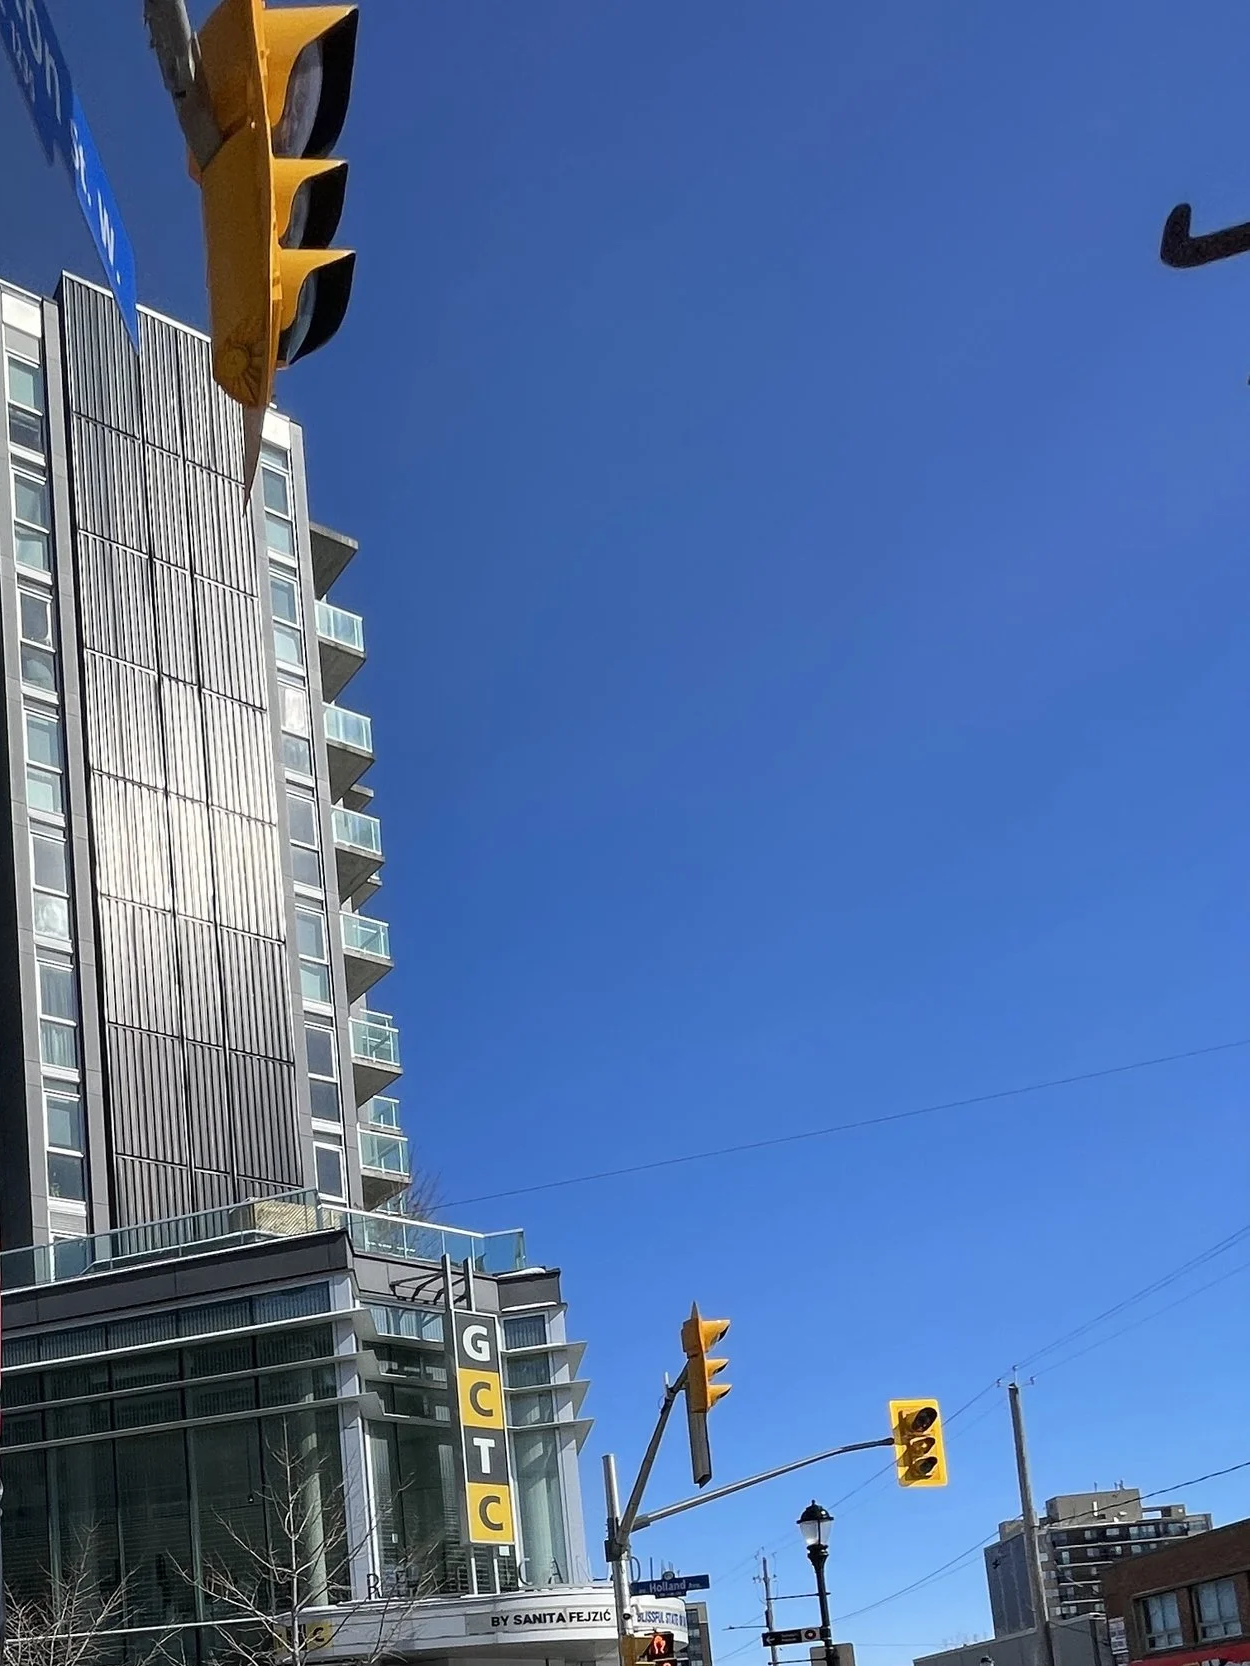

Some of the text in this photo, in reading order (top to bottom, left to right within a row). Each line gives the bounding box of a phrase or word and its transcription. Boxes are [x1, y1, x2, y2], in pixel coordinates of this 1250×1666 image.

[650, 1580, 686, 1593] Holland
[491, 1615, 509, 1627] BY
[513, 1611, 566, 1625] SANITA
[569, 1608, 611, 1624] FEJZIĆ
